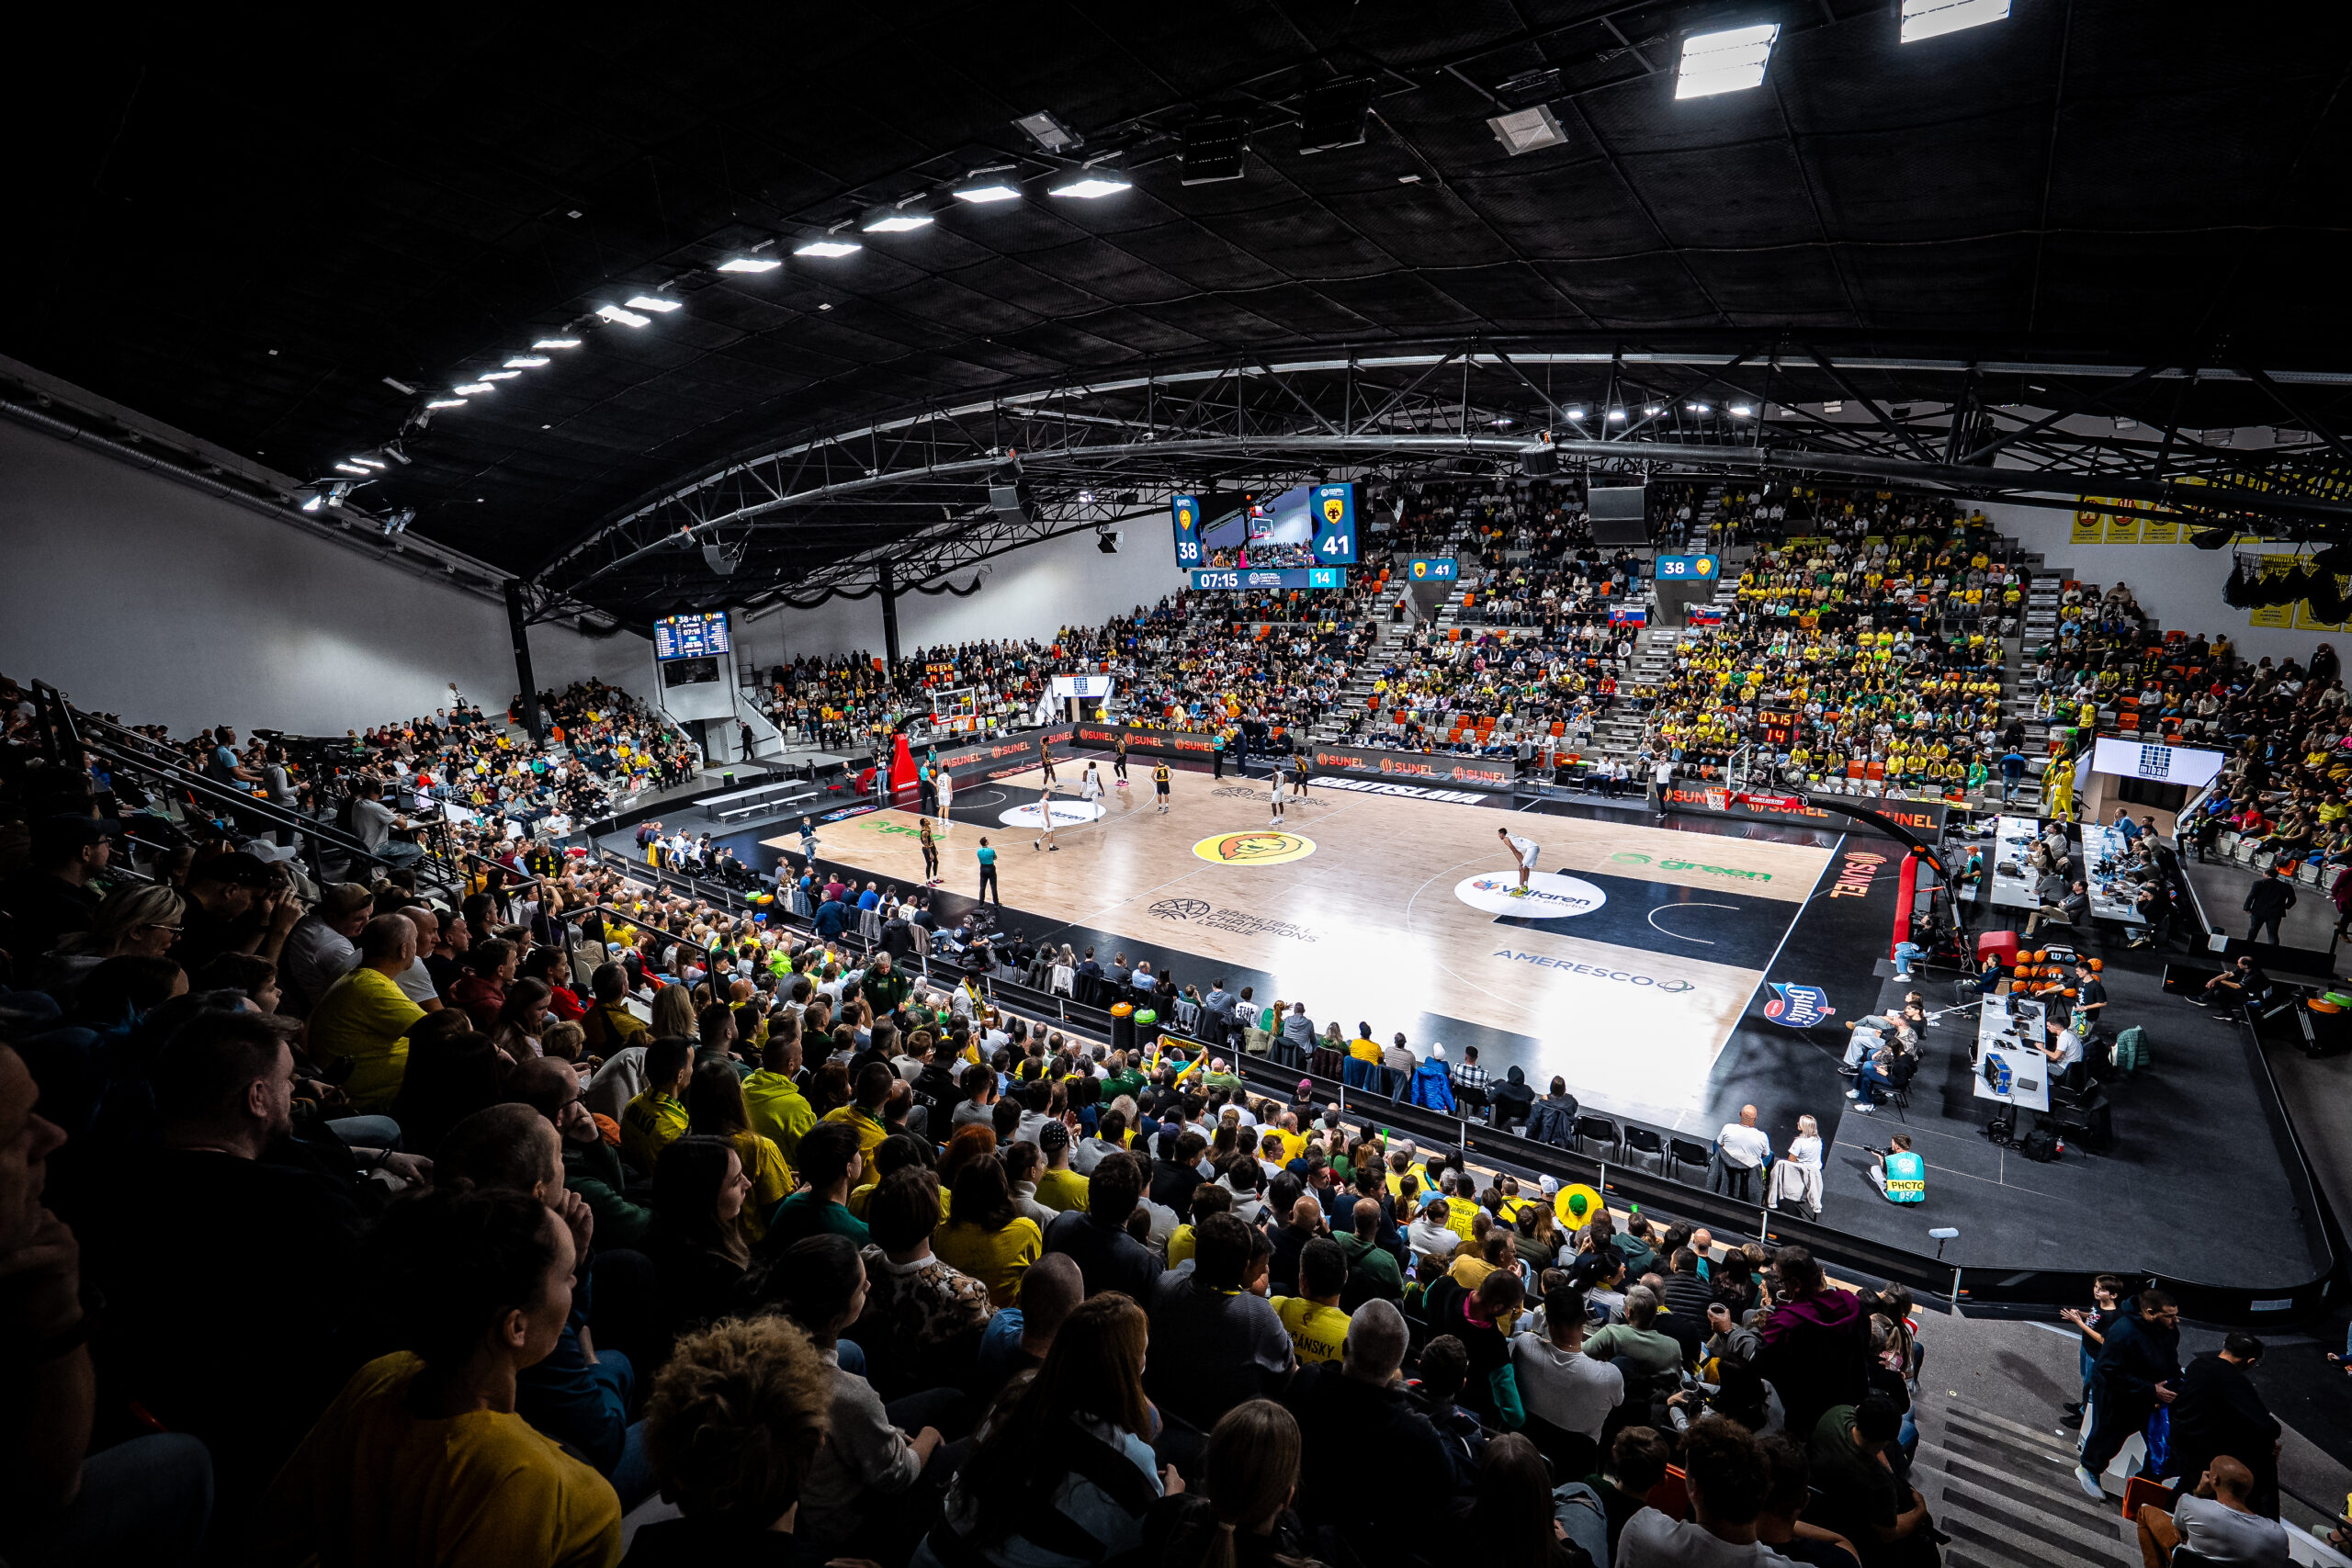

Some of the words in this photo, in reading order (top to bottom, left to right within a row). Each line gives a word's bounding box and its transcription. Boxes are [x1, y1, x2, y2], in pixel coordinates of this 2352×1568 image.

[1179, 542, 1198, 559] 38
[1323, 535, 1349, 555] 41
[1434, 564, 1450, 576] 41
[1664, 561, 1685, 574] 38
[1200, 573, 1238, 588] 07:15
[1315, 571, 1330, 584] 14
[1759, 711, 1791, 726] 07:15
[1049, 731, 1074, 744] SUNEL
[1088, 730, 1114, 741] SUNEL
[1135, 737, 1164, 747] SUNEL
[1767, 729, 1786, 743] 14
[1002, 741, 1031, 755] SUNEL
[1184, 740, 1215, 752] SUNEL
[950, 752, 982, 768] SUNEL
[1329, 755, 1366, 768] SUNEL
[1395, 762, 1436, 776] SUNEL
[2140, 765, 2168, 776] mibau
[1465, 770, 1510, 784] SUNEL
[1307, 776, 1488, 805] BRATISLAVA
[1658, 859, 1773, 881] green
[1829, 862, 1878, 898] SUNEL
[1196, 919, 1258, 936] LEAGUE
[1216, 908, 1312, 934] BASKETBALL
[1206, 914, 1320, 943] CHAMPIONS
[1493, 950, 1654, 986] AMERESCO
[1891, 1181, 1924, 1190] PHOTO
